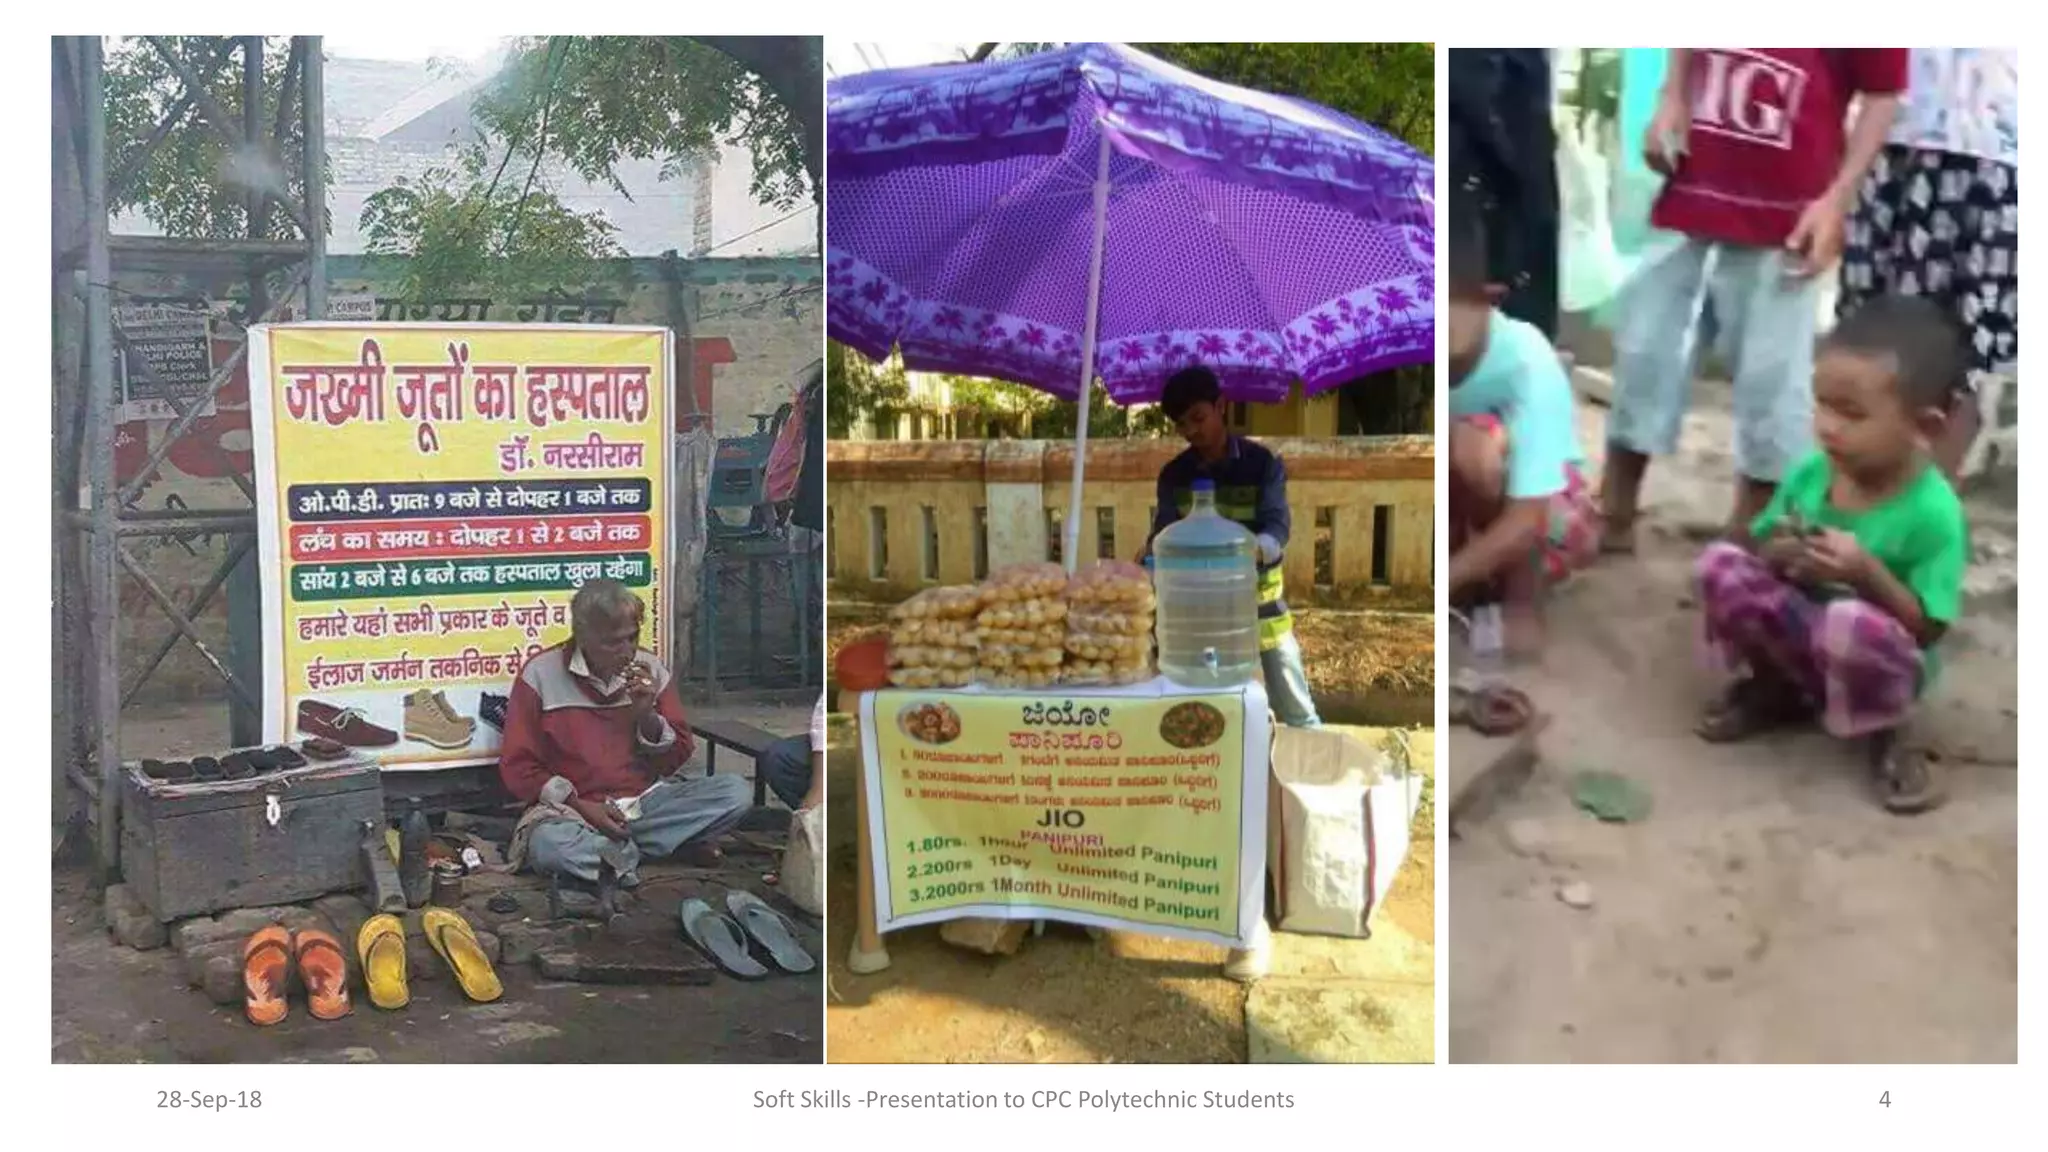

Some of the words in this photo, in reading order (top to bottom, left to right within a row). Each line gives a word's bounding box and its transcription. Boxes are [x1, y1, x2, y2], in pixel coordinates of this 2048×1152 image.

[393, 342, 468, 453] जूतों
[473, 366, 518, 421] का
[526, 366, 651, 427] हस्पताल
[542, 433, 645, 469] नरसीराम
[434, 494, 446, 510] 9
[485, 486, 503, 508] से
[506, 486, 560, 510] दोपहर
[564, 491, 572, 507] 1
[610, 488, 642, 505] तक
[342, 531, 373, 550] का
[376, 530, 432, 549] समय
[450, 523, 513, 547] दोपहर
[516, 528, 524, 545] 1
[530, 520, 550, 544] से
[554, 527, 565, 543] 2
[607, 523, 643, 541] तक
[340, 572, 350, 589] 2
[390, 563, 407, 587] से
[411, 568, 421, 586] 6
[458, 565, 490, 584] तक
[493, 562, 561, 584] हस्पताल
[563, 562, 601, 588] खुला
[605, 555, 644, 580] रहेगा
[298, 608, 349, 640] हमारे
[352, 606, 388, 637] यहां
[392, 603, 435, 633] सभी
[440, 609, 488, 635] प्रकार
[491, 600, 511, 628] के
[514, 599, 549, 637] जूते
[553, 606, 566, 625] व
[307, 656, 366, 689] ईलाज
[370, 651, 425, 681] जर्मन
[429, 648, 502, 679] तकनिक
[1036, 809, 1086, 828] JIO
[980, 835, 1030, 850] 1hour
[1050, 844, 1137, 859] Unlimited
[1141, 845, 1218, 870] Panipuri
[1020, 829, 1104, 847] PANIPURI
[907, 859, 973, 879] 2.200rs
[989, 854, 1032, 870] 1Day
[1057, 862, 1139, 883] Unlimited
[1144, 872, 1220, 895] Panipuri
[909, 880, 985, 902] 3.2000rs
[992, 877, 1052, 895] 1Month
[1057, 882, 1139, 910] Unlimited
[1144, 897, 1220, 921] Panipuri
